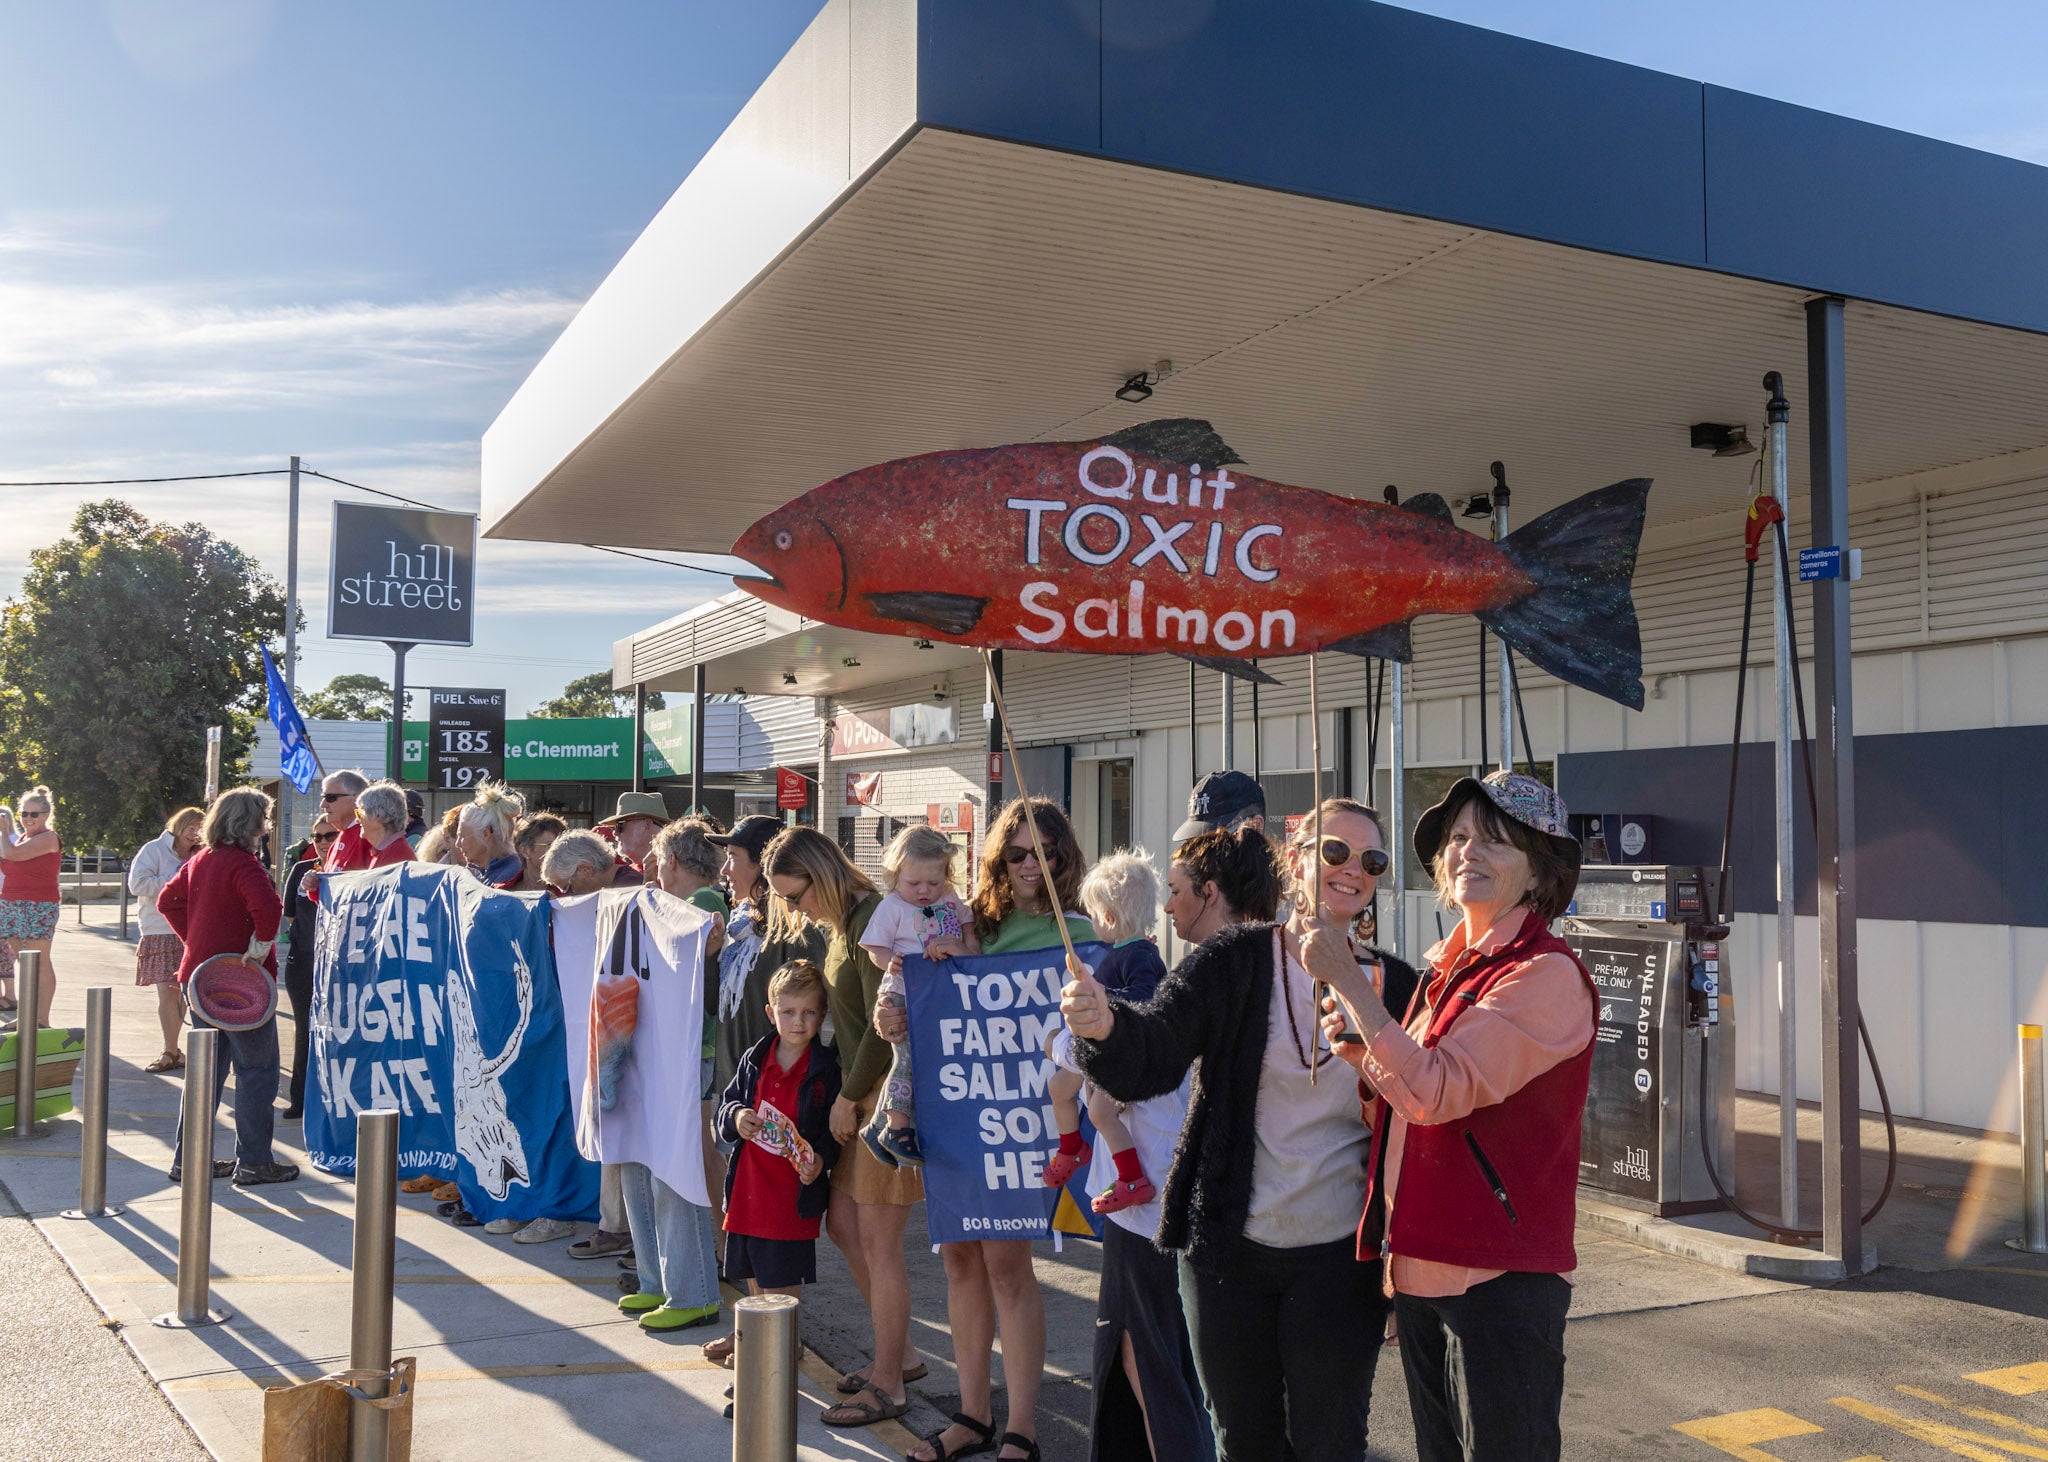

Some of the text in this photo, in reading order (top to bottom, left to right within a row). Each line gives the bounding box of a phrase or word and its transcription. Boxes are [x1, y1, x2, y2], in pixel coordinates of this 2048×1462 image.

[1079, 445, 1236, 510] Quit
[1006, 497, 1284, 583] TOXIC
[386, 541, 454, 582] hill
[1800, 550, 1839, 560] Surveillance
[1800, 561, 1828, 569] cameras
[341, 572, 462, 611] street
[1015, 580, 1296, 651] Salmon
[433, 693, 465, 704] FUEL
[469, 695, 489, 705] Save
[441, 731, 488, 752] 185
[525, 740, 619, 758] Chemmart
[1656, 905, 1662, 917] 1
[1595, 964, 1629, 977] PRE-PAY
[1610, 977, 1632, 989] ONLY
[1637, 955, 1656, 1060] UNLEADED
[940, 1012, 1061, 1056] FARM
[939, 1058, 1056, 1101] SALM
[399, 1150, 458, 1171] UNDATION
[1626, 1146, 1648, 1167] hill
[984, 1148, 1059, 1190] HE
[1613, 1160, 1651, 1182] street
[962, 1217, 1049, 1231] BOB BROWN
